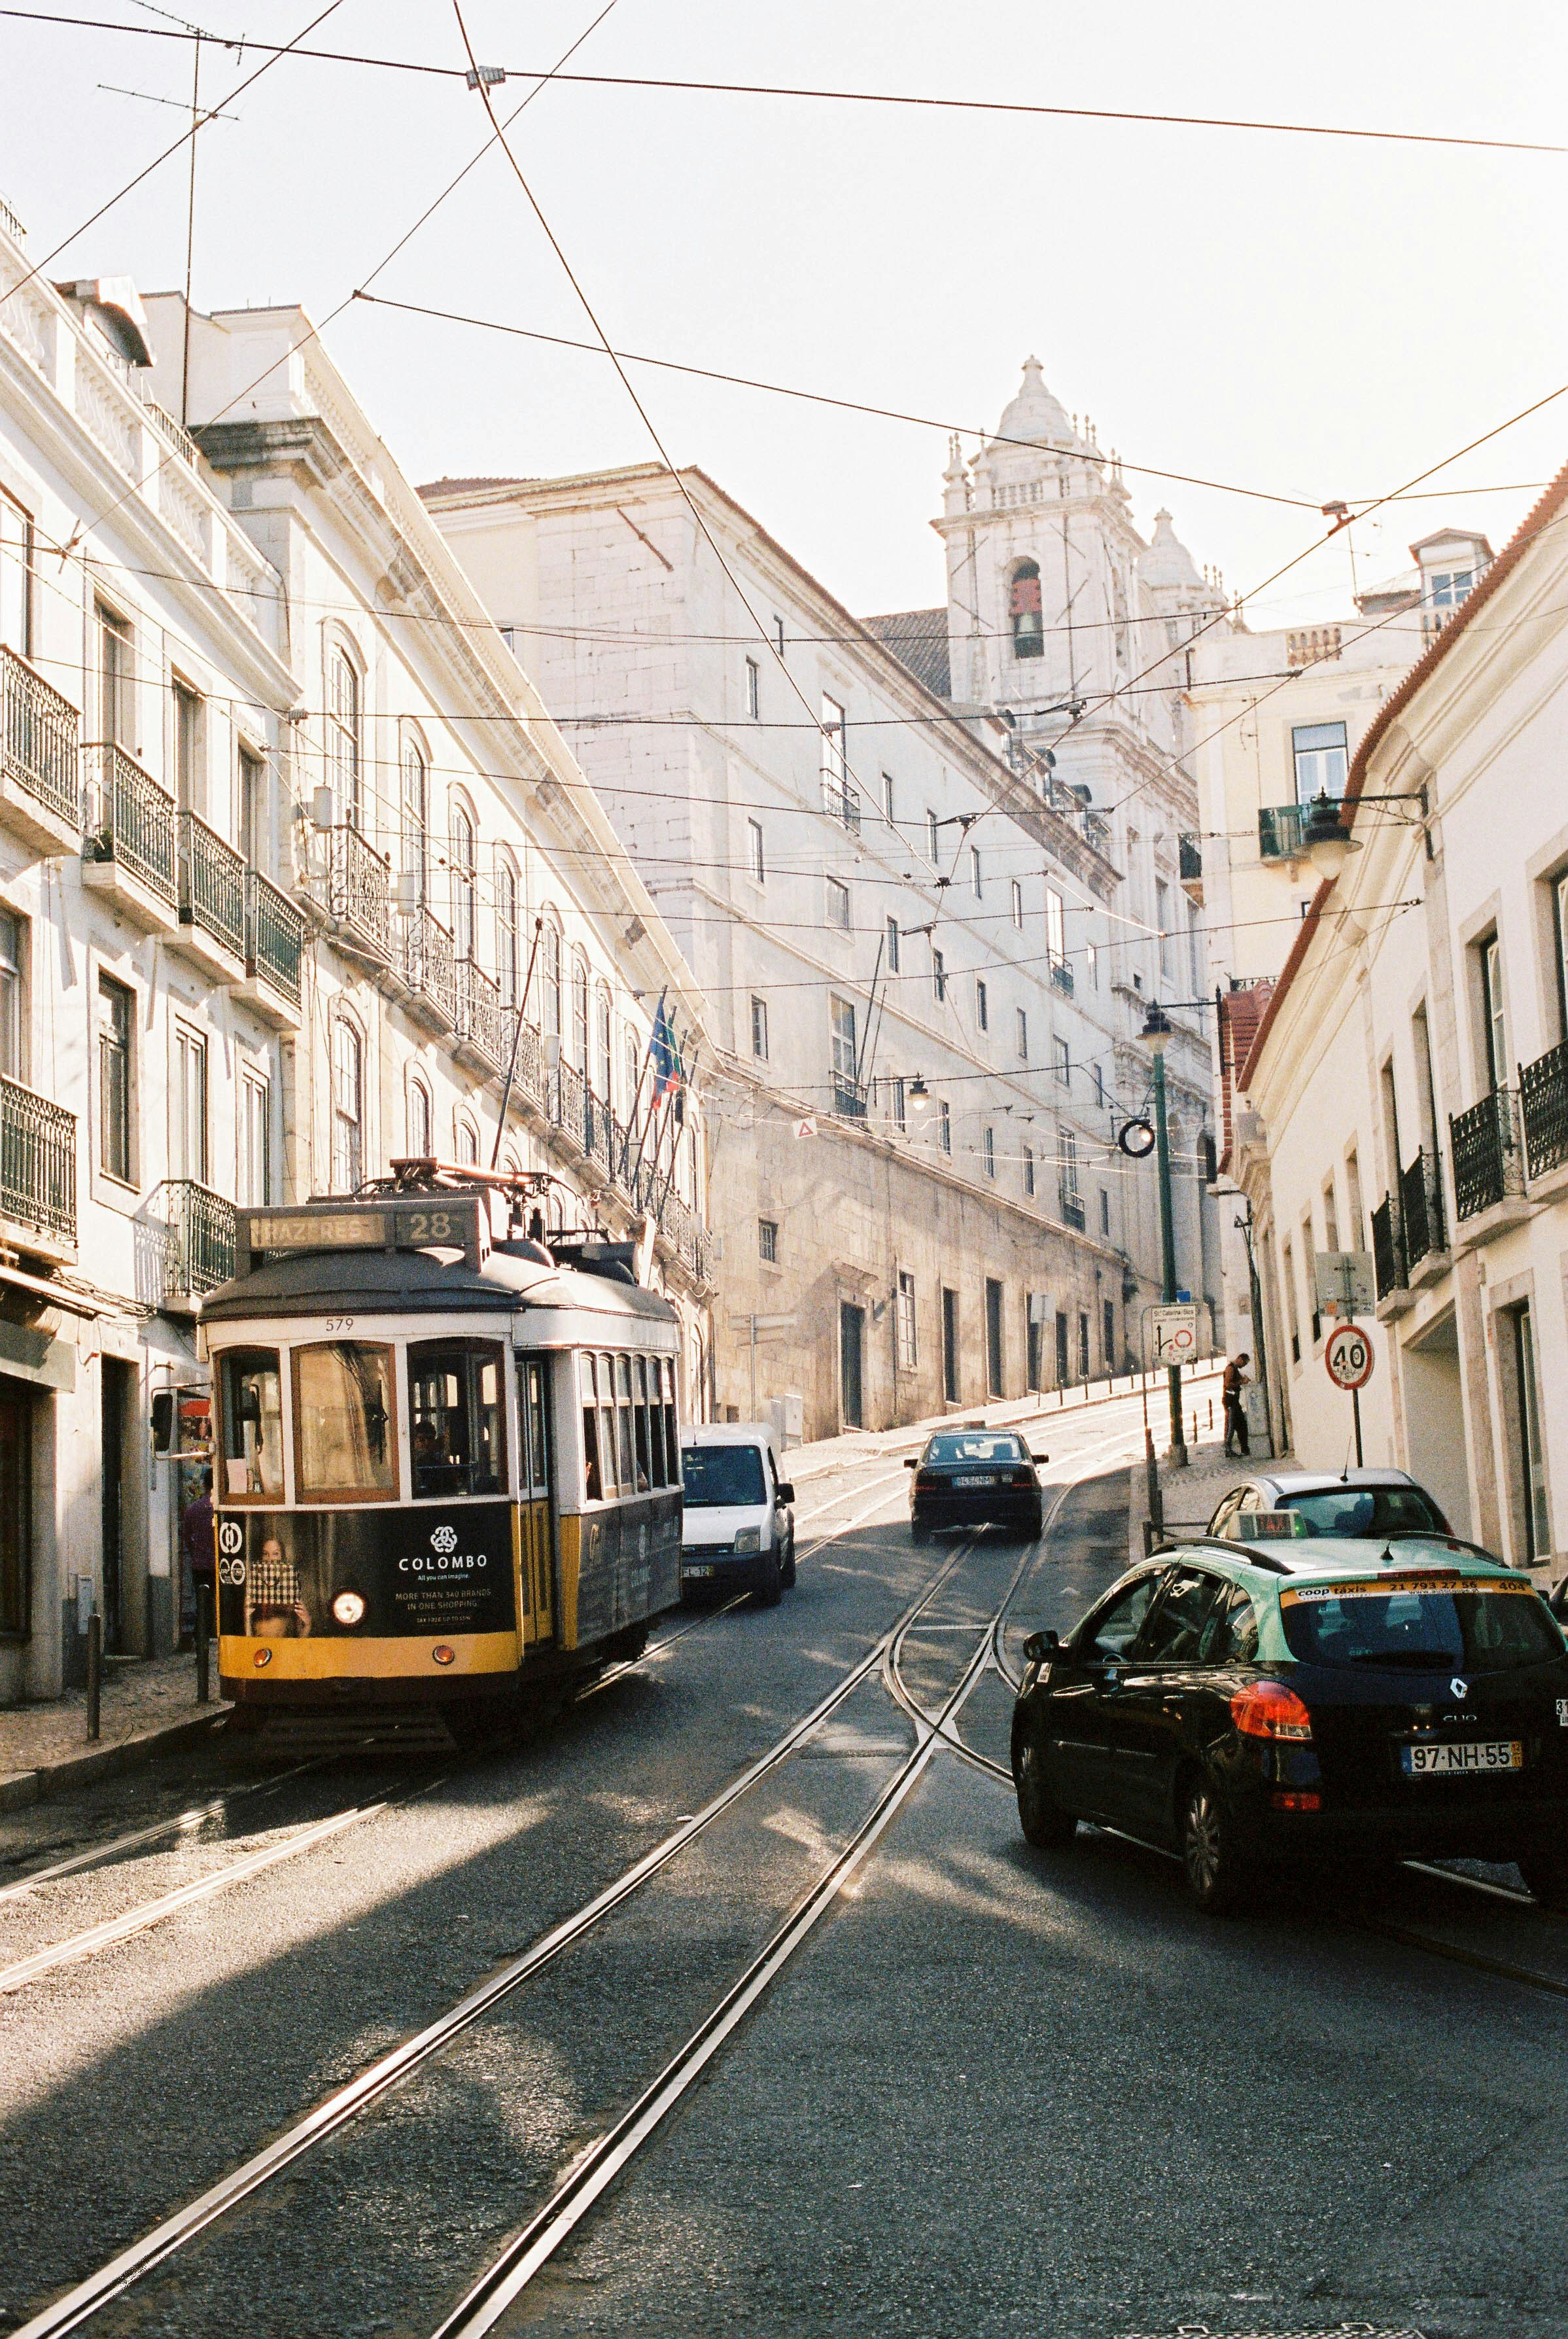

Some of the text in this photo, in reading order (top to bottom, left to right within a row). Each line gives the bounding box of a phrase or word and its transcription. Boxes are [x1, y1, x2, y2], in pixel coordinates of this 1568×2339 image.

[410, 1212, 451, 1239] 28
[326, 1318, 354, 1331] 579
[1333, 1344, 1365, 1370] 40
[398, 1555, 487, 1571] COLOMBO
[1298, 1588, 1330, 1596] coop
[1499, 1582, 1525, 1591] 404
[395, 1592, 419, 1601] MORE
[422, 1591, 444, 1600] THAN
[461, 1589, 492, 1598] BRANDS
[419, 1602, 436, 1610] ONE
[438, 1600, 477, 1609] SHOPPING
